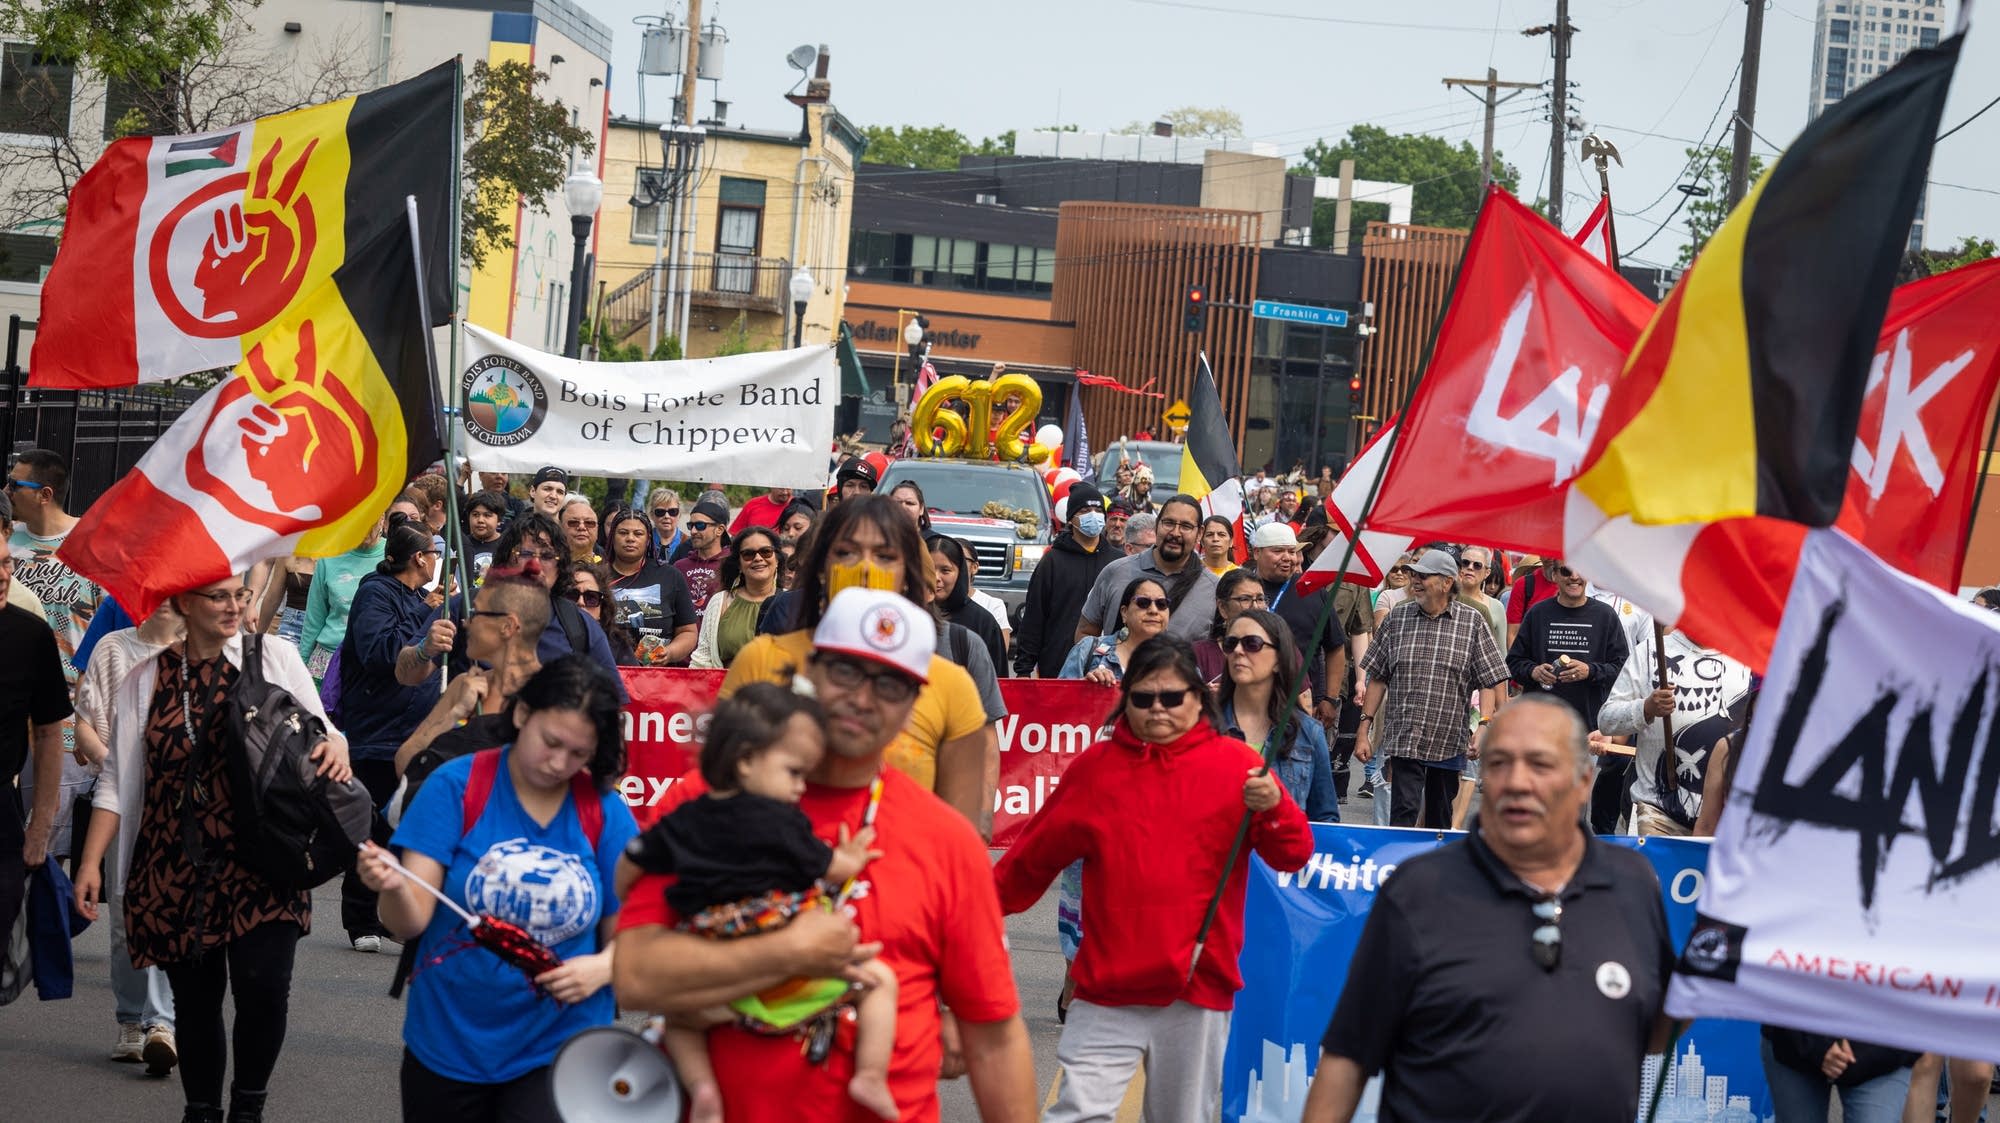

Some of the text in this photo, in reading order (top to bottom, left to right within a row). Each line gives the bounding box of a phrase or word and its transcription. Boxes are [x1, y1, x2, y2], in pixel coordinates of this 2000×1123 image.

[1259, 305, 1341, 322] E Franklin Av
[849, 320, 981, 349] dian enter
[462, 356, 544, 400] BOIS FORTE BAND
[560, 377, 822, 414] Bois Forte Band
[466, 420, 532, 446] OF CHIPPEWA
[581, 416, 797, 452] of Chippewa
[912, 373, 1049, 464] 612
[12, 559, 74, 584] lways
[1766, 948, 1964, 999] AMERICAN
